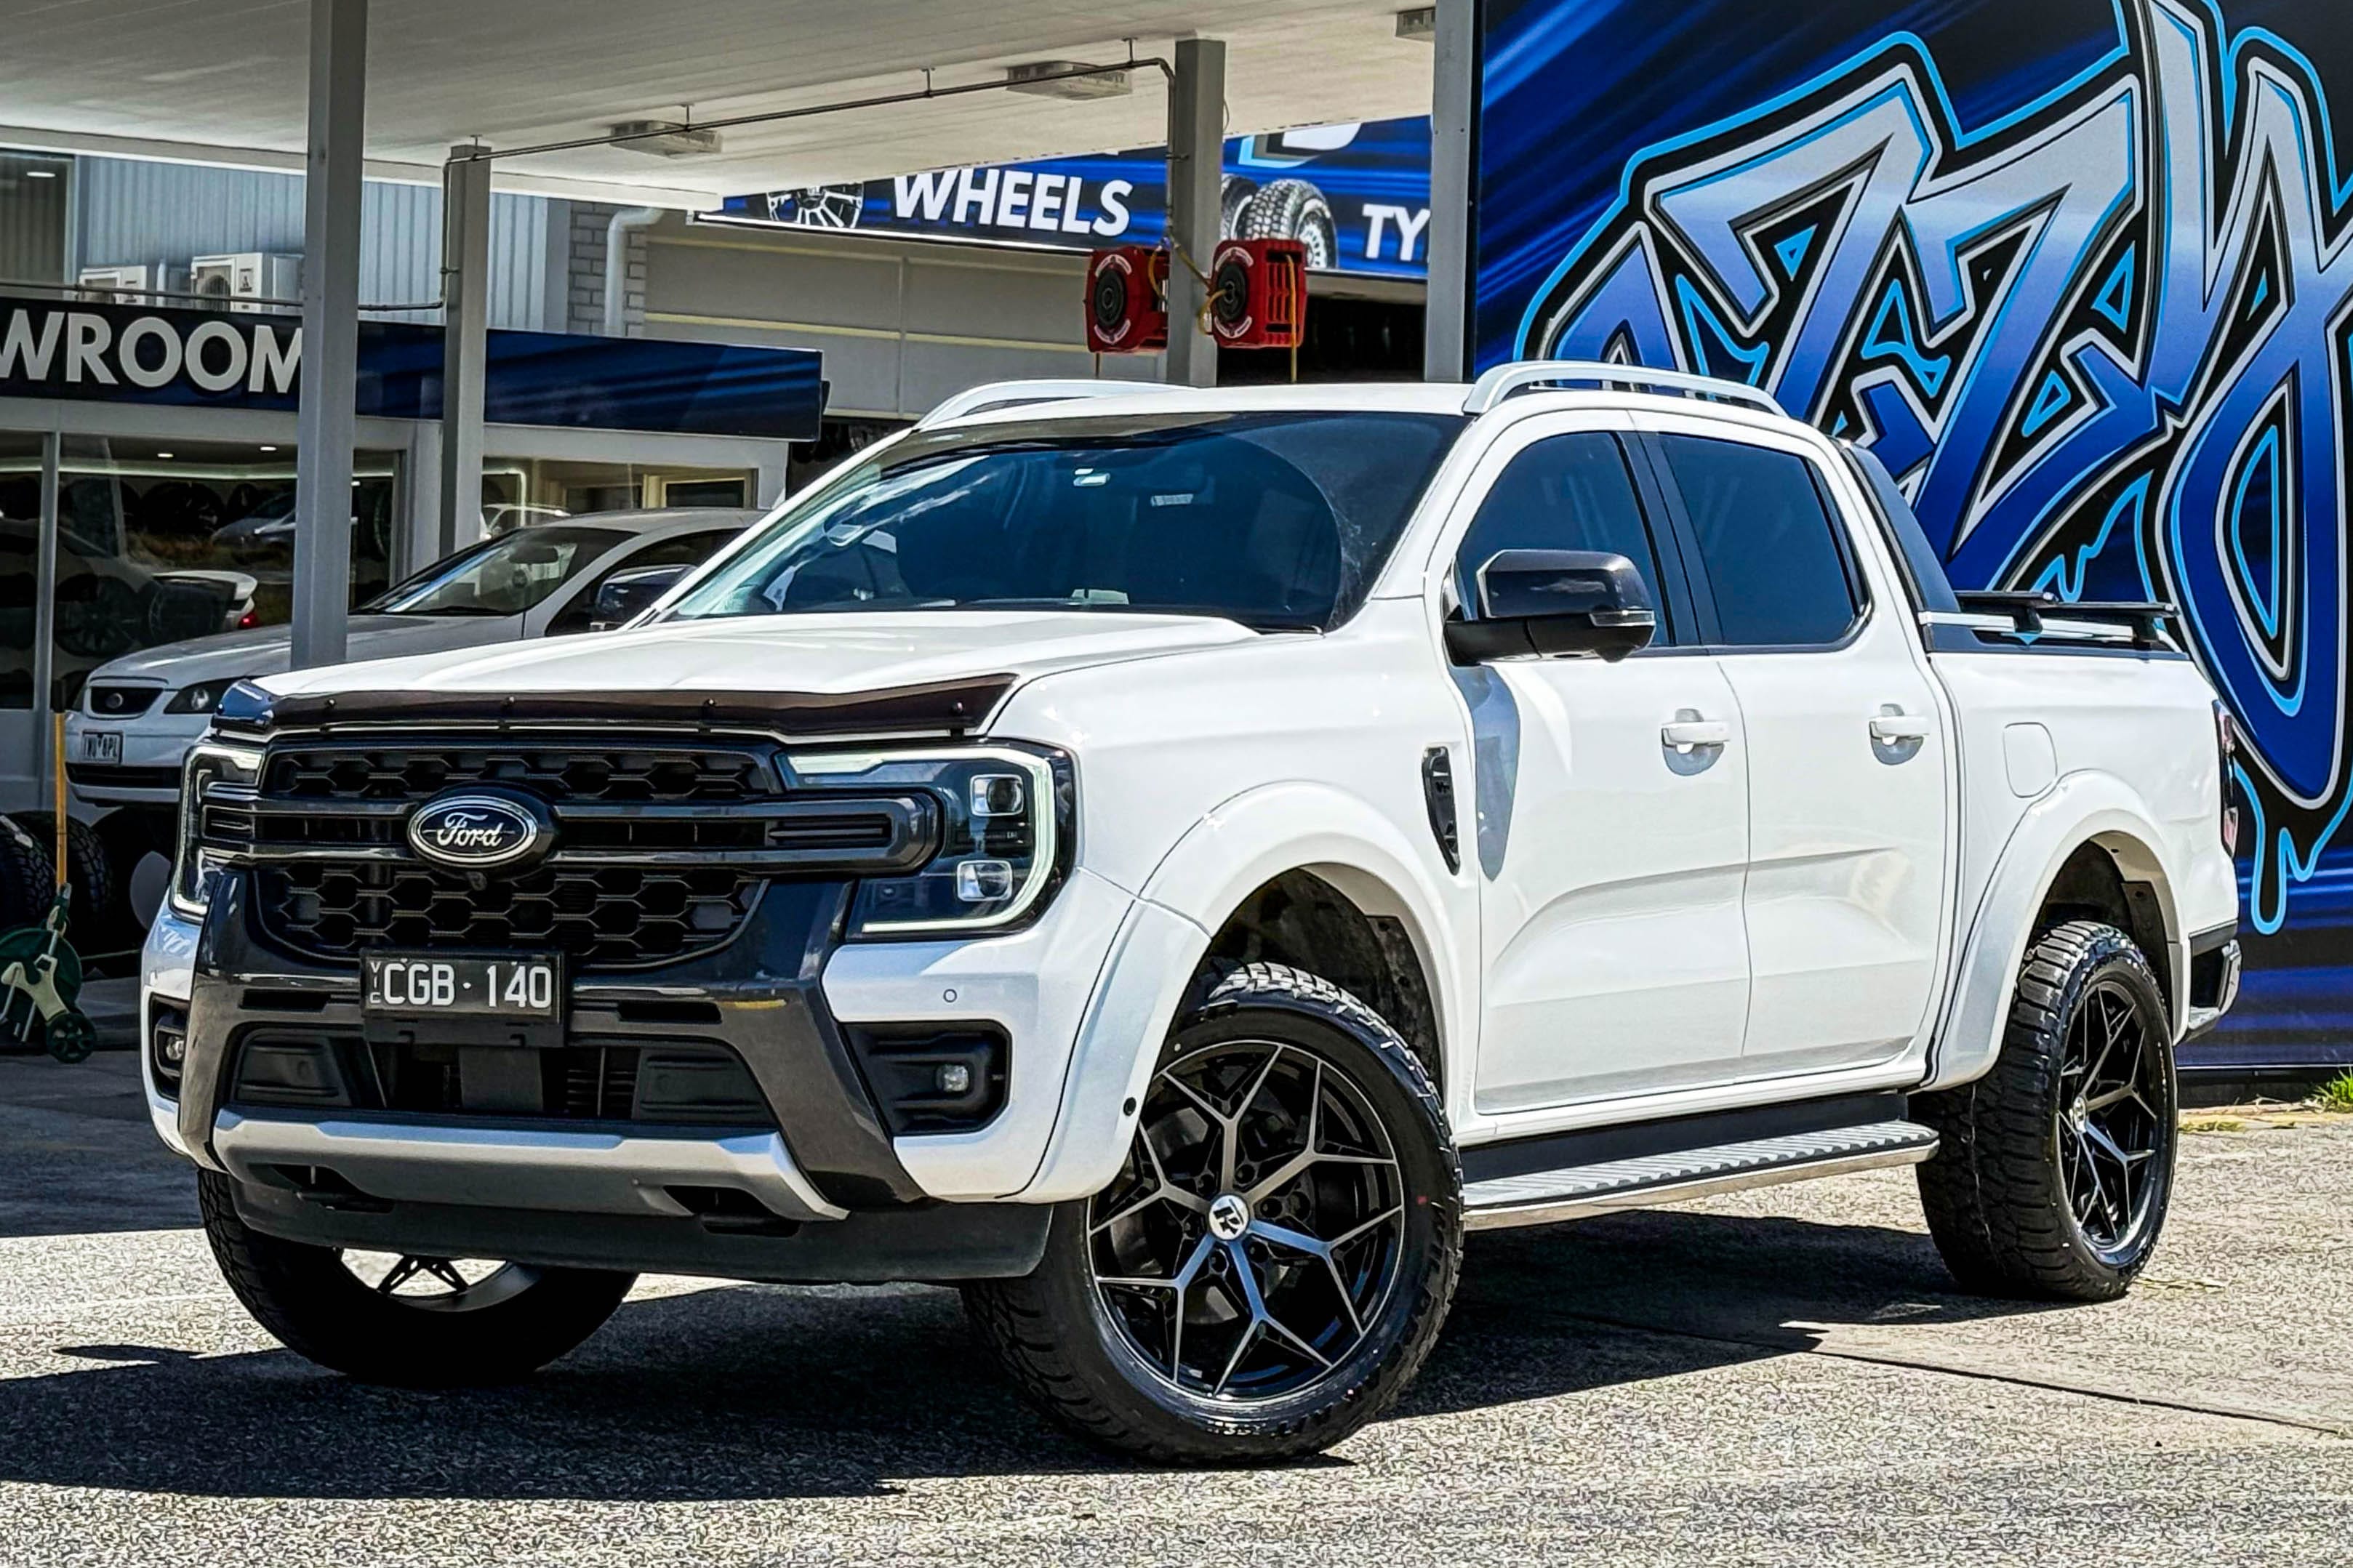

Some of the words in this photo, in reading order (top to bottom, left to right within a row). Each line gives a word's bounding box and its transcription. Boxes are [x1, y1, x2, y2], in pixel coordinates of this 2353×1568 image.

[894, 168, 1134, 237] WHEELS
[1362, 204, 1431, 261] TY
[0, 309, 302, 393] WROOM
[437, 812, 503, 847] Ford
[369, 962, 382, 1005] VIC
[384, 962, 455, 1005] CGB
[486, 965, 552, 1008] 140
